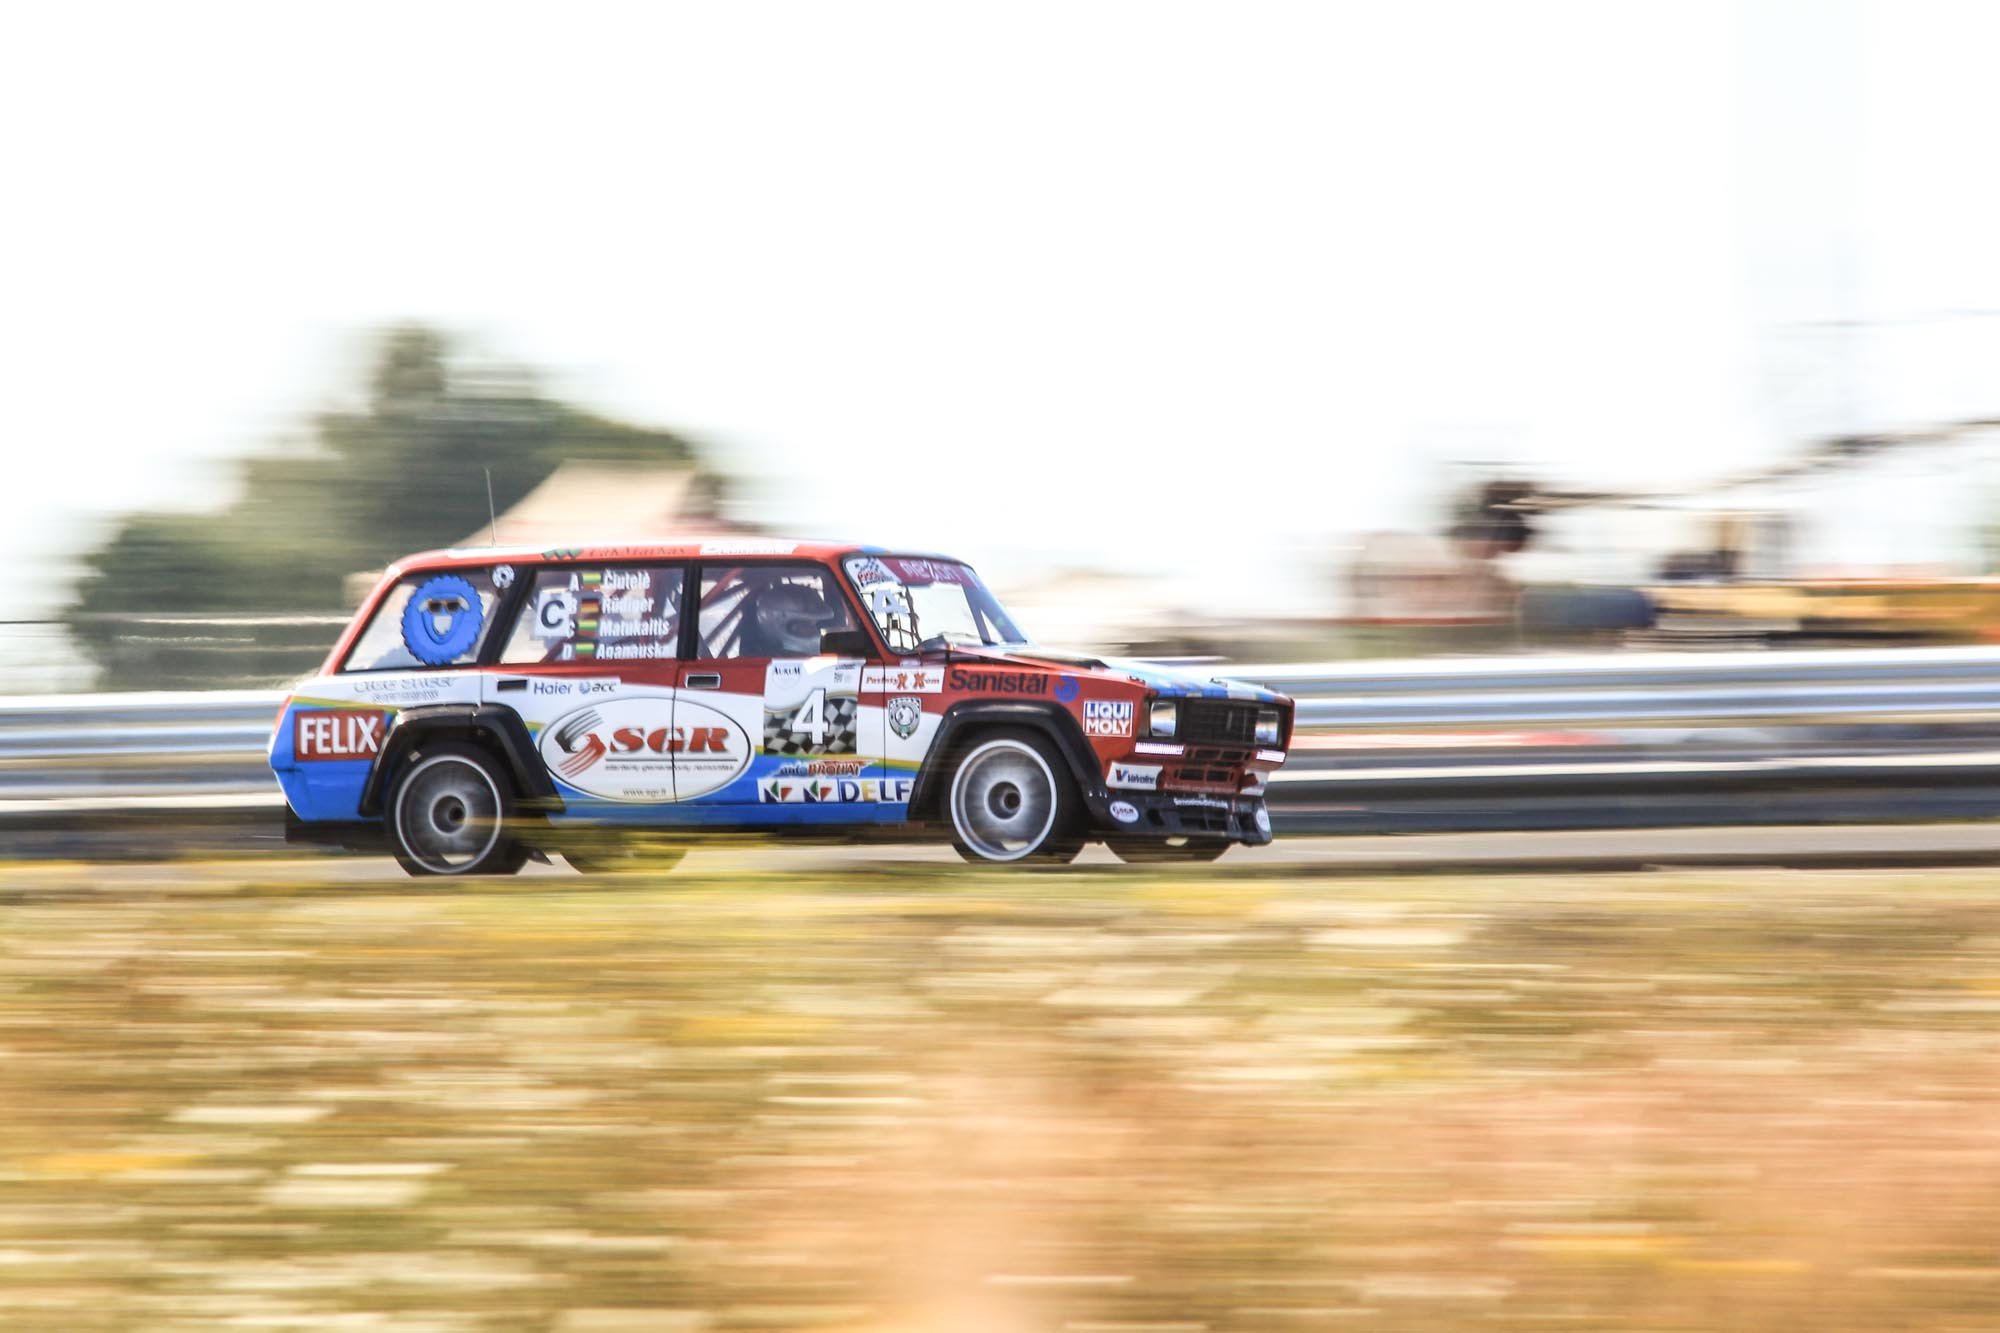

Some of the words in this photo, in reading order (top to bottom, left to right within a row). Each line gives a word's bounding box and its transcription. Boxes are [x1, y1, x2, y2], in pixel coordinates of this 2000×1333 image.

[569, 572, 579, 591] A
[541, 600, 566, 629] C
[600, 618, 670, 636] Matukaitis
[562, 643, 572, 660] D
[533, 682, 572, 695] Haier
[592, 681, 617, 693] acc
[791, 687, 830, 745] 4
[1086, 702, 1130, 719] LIQUI
[300, 715, 379, 754] FELIX
[1085, 719, 1130, 735] MOLY
[609, 726, 730, 754] SGR
